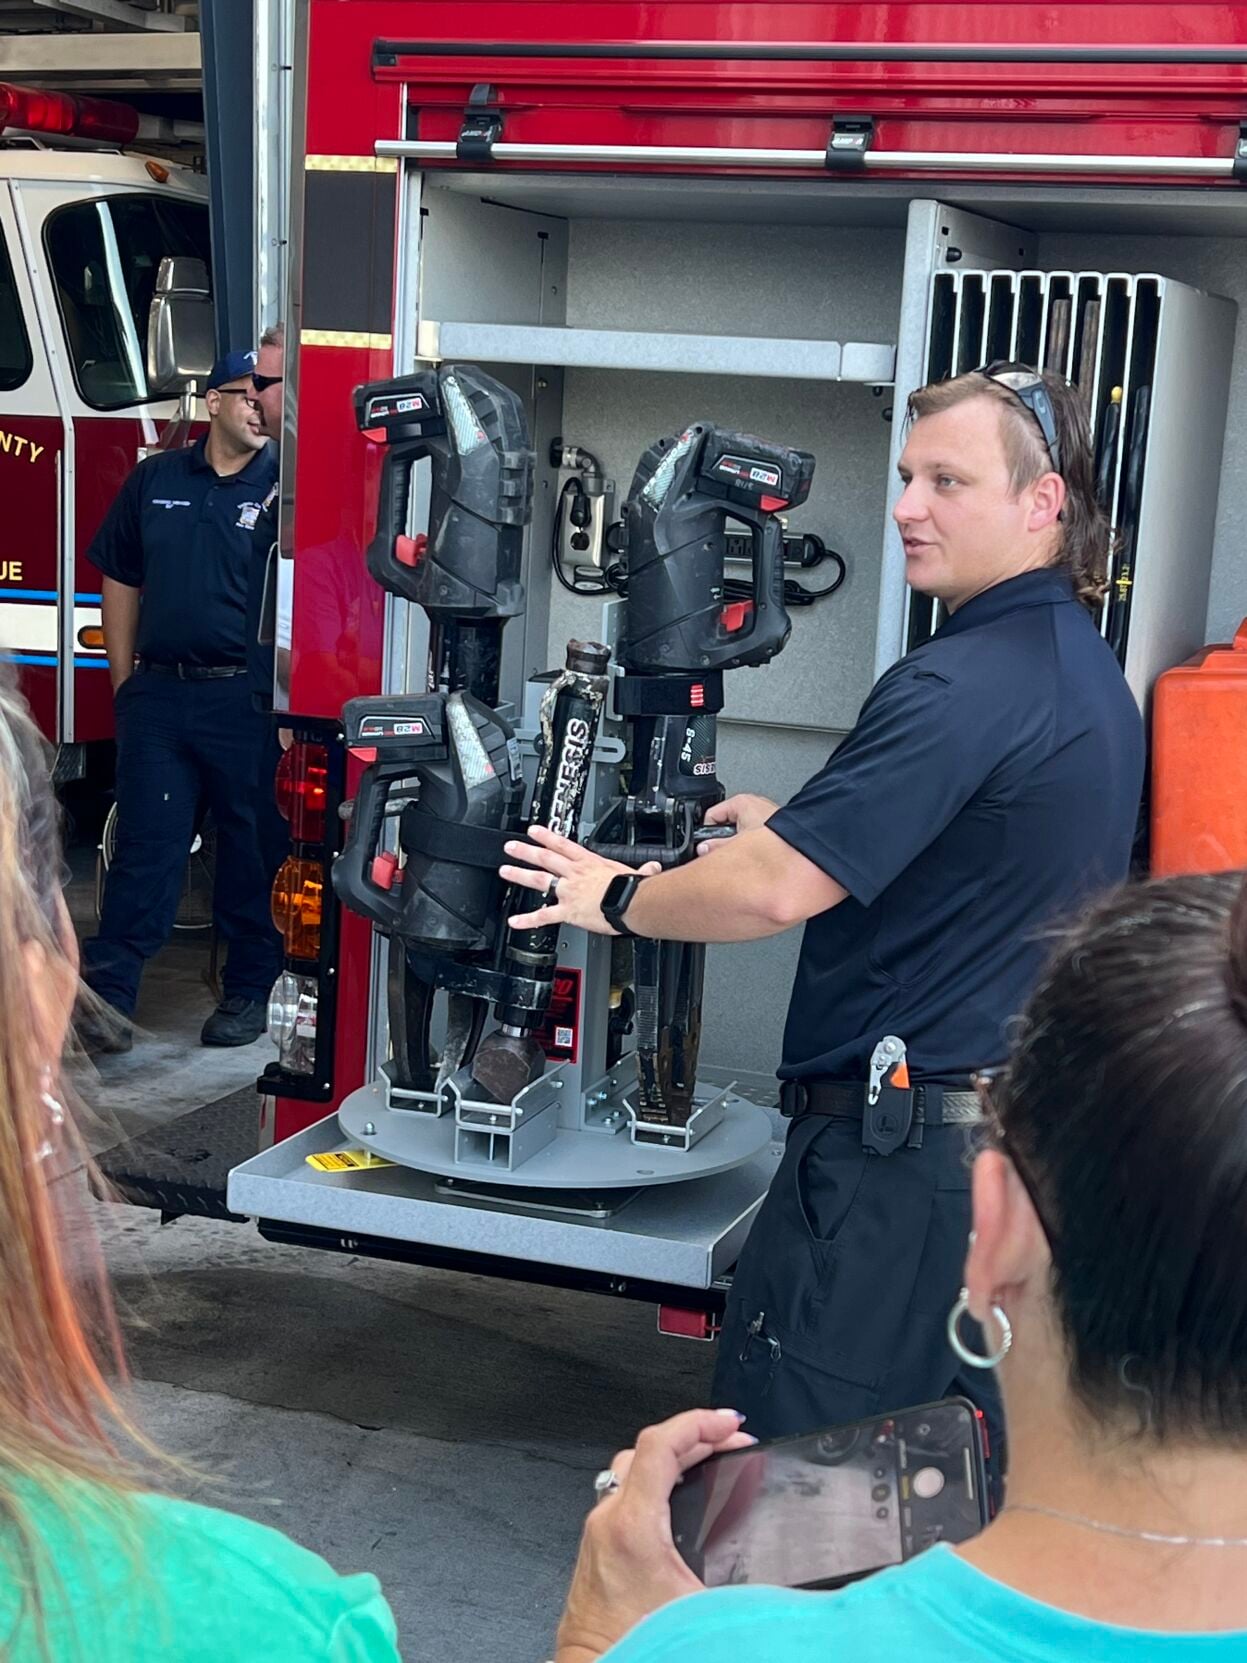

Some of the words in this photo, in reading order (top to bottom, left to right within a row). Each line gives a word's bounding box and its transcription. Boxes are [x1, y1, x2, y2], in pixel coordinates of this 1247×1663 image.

[398, 399, 421, 411] M28
[0, 431, 44, 463] NTY
[752, 469, 778, 484] M28
[396, 724, 421, 733] M28
